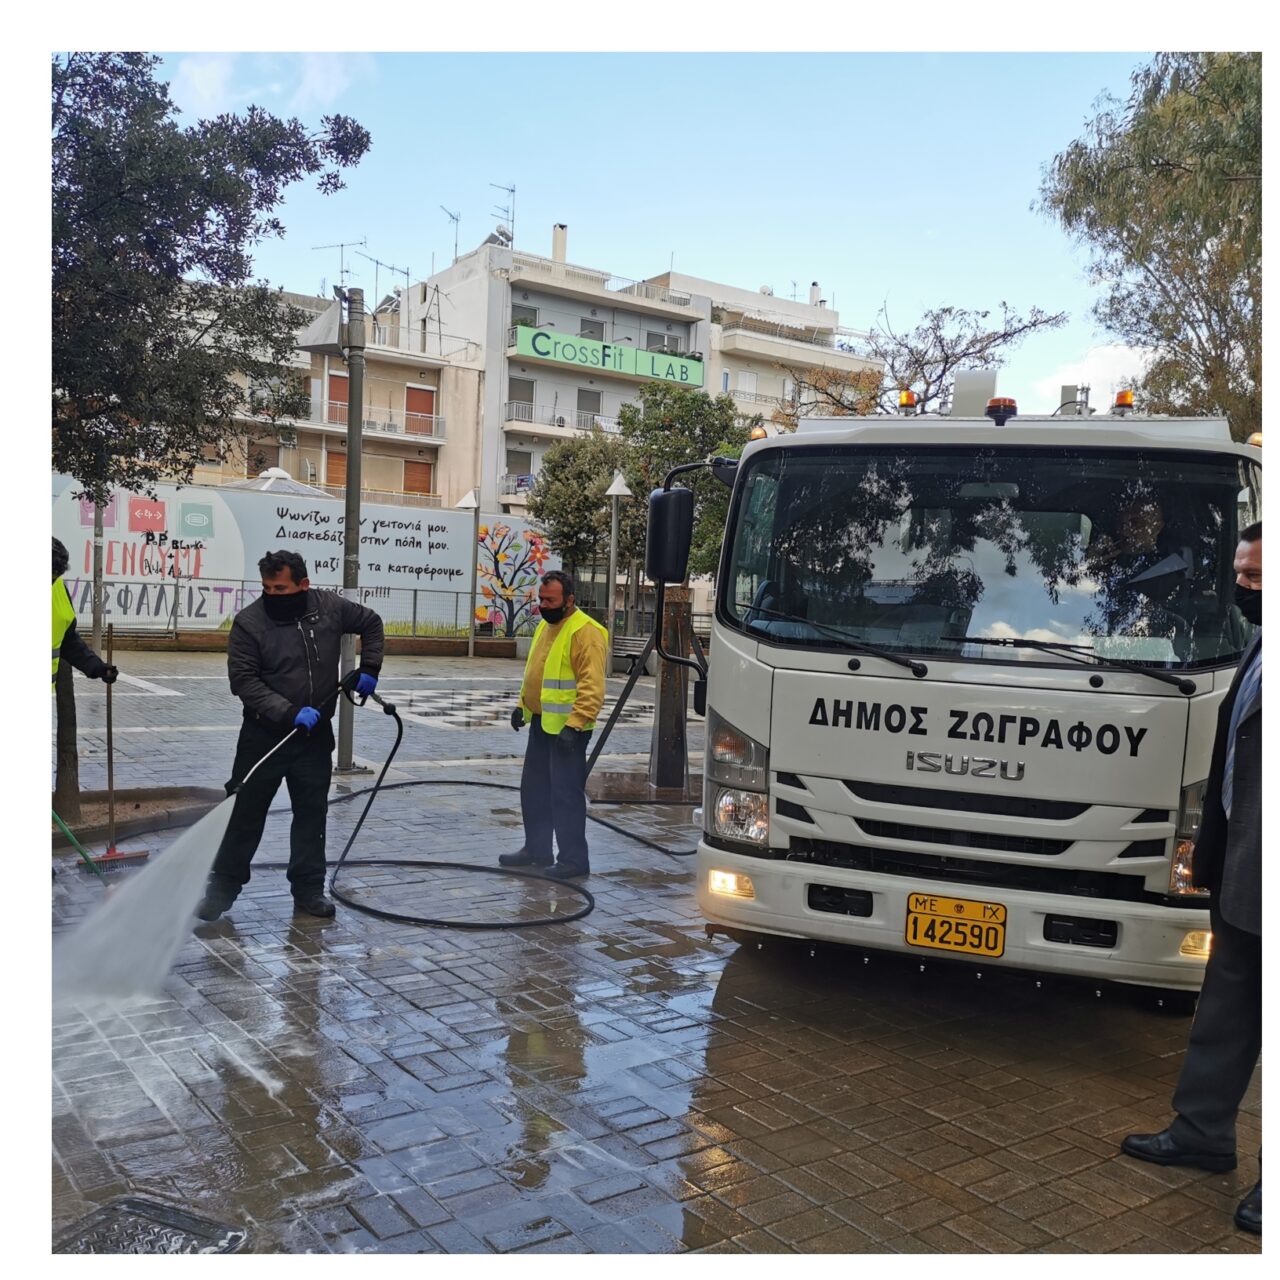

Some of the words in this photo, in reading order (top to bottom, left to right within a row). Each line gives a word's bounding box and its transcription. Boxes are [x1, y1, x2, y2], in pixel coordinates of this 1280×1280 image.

[531, 331, 624, 370] CrossFit
[651, 356, 689, 382] LAB
[276, 507, 330, 526] Ψωνίζω
[372, 519, 421, 533] γειτονιά
[275, 526, 346, 545] Διασκεδάζ
[360, 537, 389, 547] στην
[395, 537, 422, 549] πόλη
[315, 557, 339, 574] μαζί
[367, 563, 381, 572] τα
[388, 562, 464, 581] καταφέρουμε
[809, 698, 928, 736] ΔΗΜΟΣ
[947, 709, 1147, 758] ΖΩΓΡΑΦΟΥ
[906, 751, 1026, 781] ISUZU
[912, 916, 998, 951] 142590
